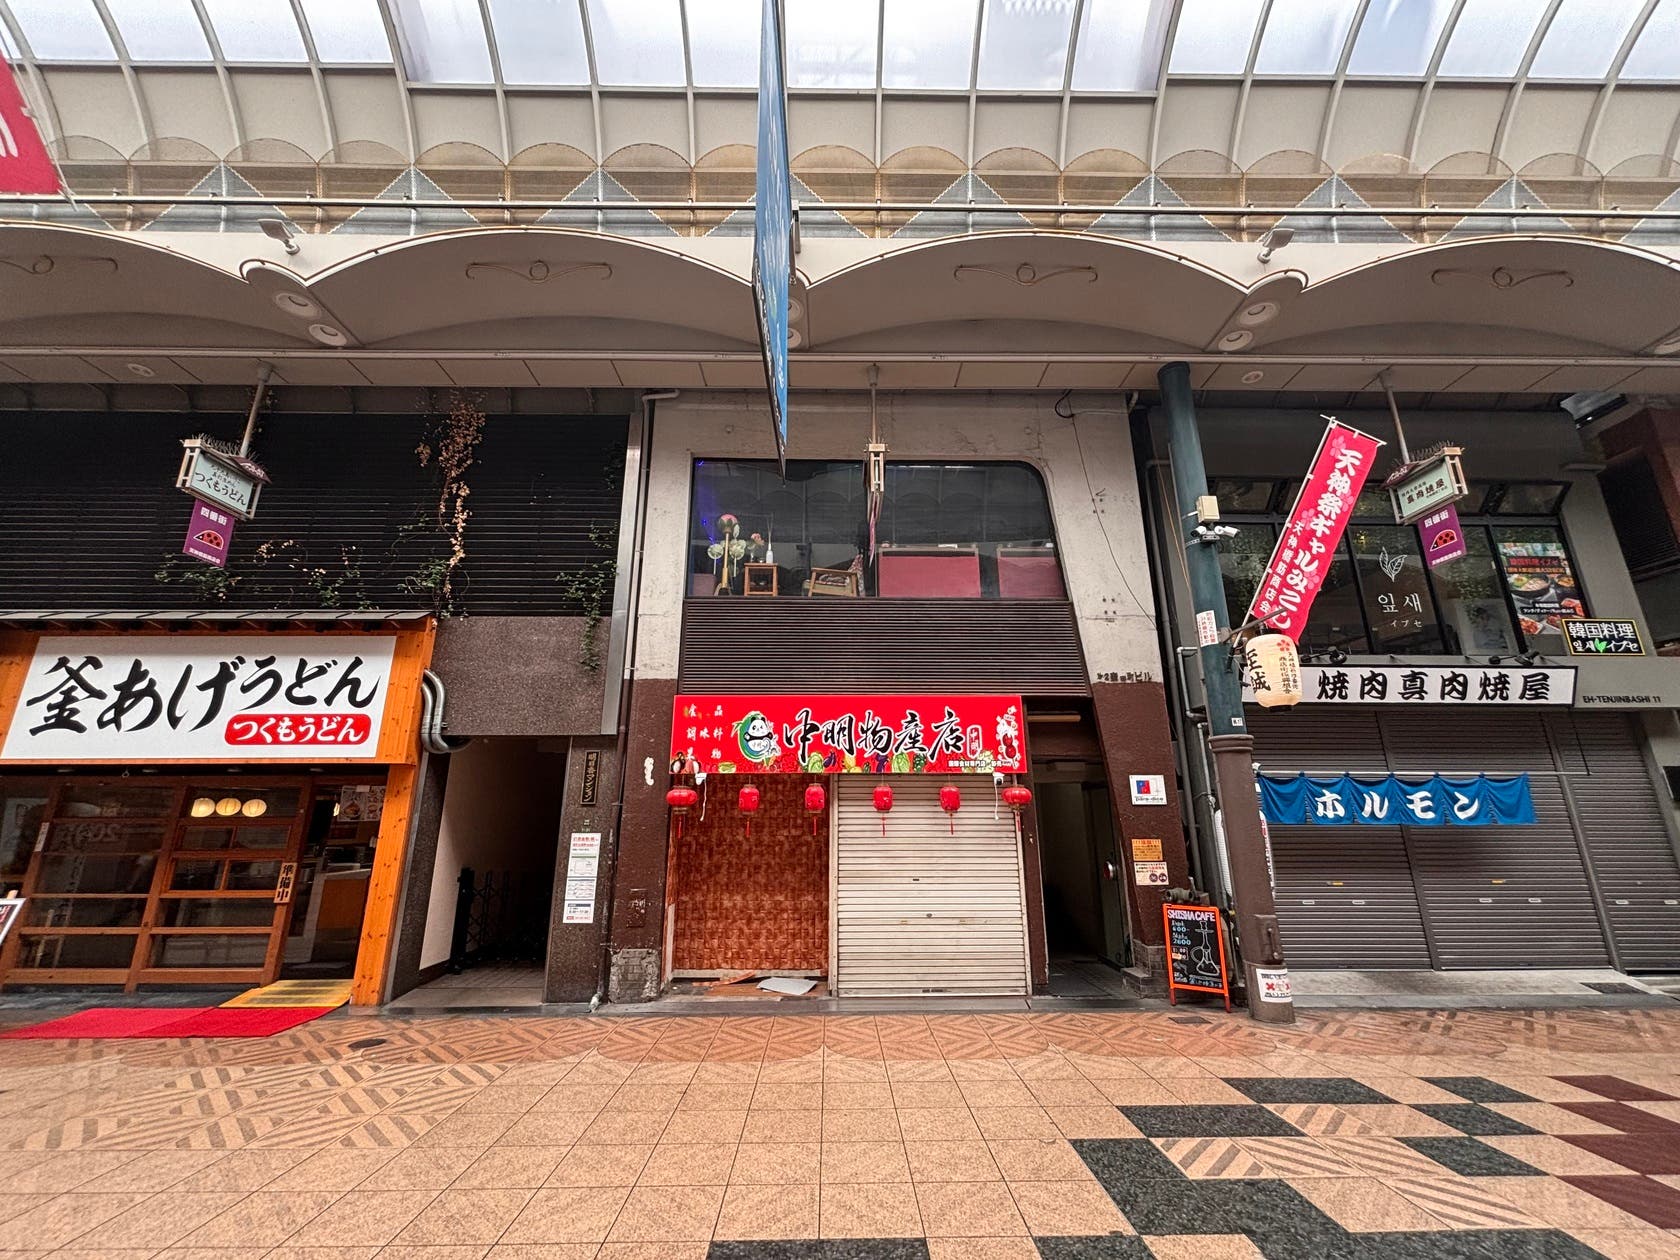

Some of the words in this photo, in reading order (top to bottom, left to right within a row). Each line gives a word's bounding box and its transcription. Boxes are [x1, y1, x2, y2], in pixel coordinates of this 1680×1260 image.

[195, 471, 247, 506] つくもうどん
[1424, 510, 1449, 528] 四番街
[1568, 623, 1636, 639] 韓国料理
[27, 656, 382, 736] 釜あげうどん
[1316, 669, 1551, 702] 焼肉真肉焼屋
[1583, 695, 1650, 704] EH-TENJINBASHI
[233, 718, 364, 744] つくもうどん
[687, 727, 723, 742] 調味料
[1316, 790, 1479, 820] ホルモン
[277, 864, 294, 902] 準備中
[1195, 911, 1216, 922] CAFE
